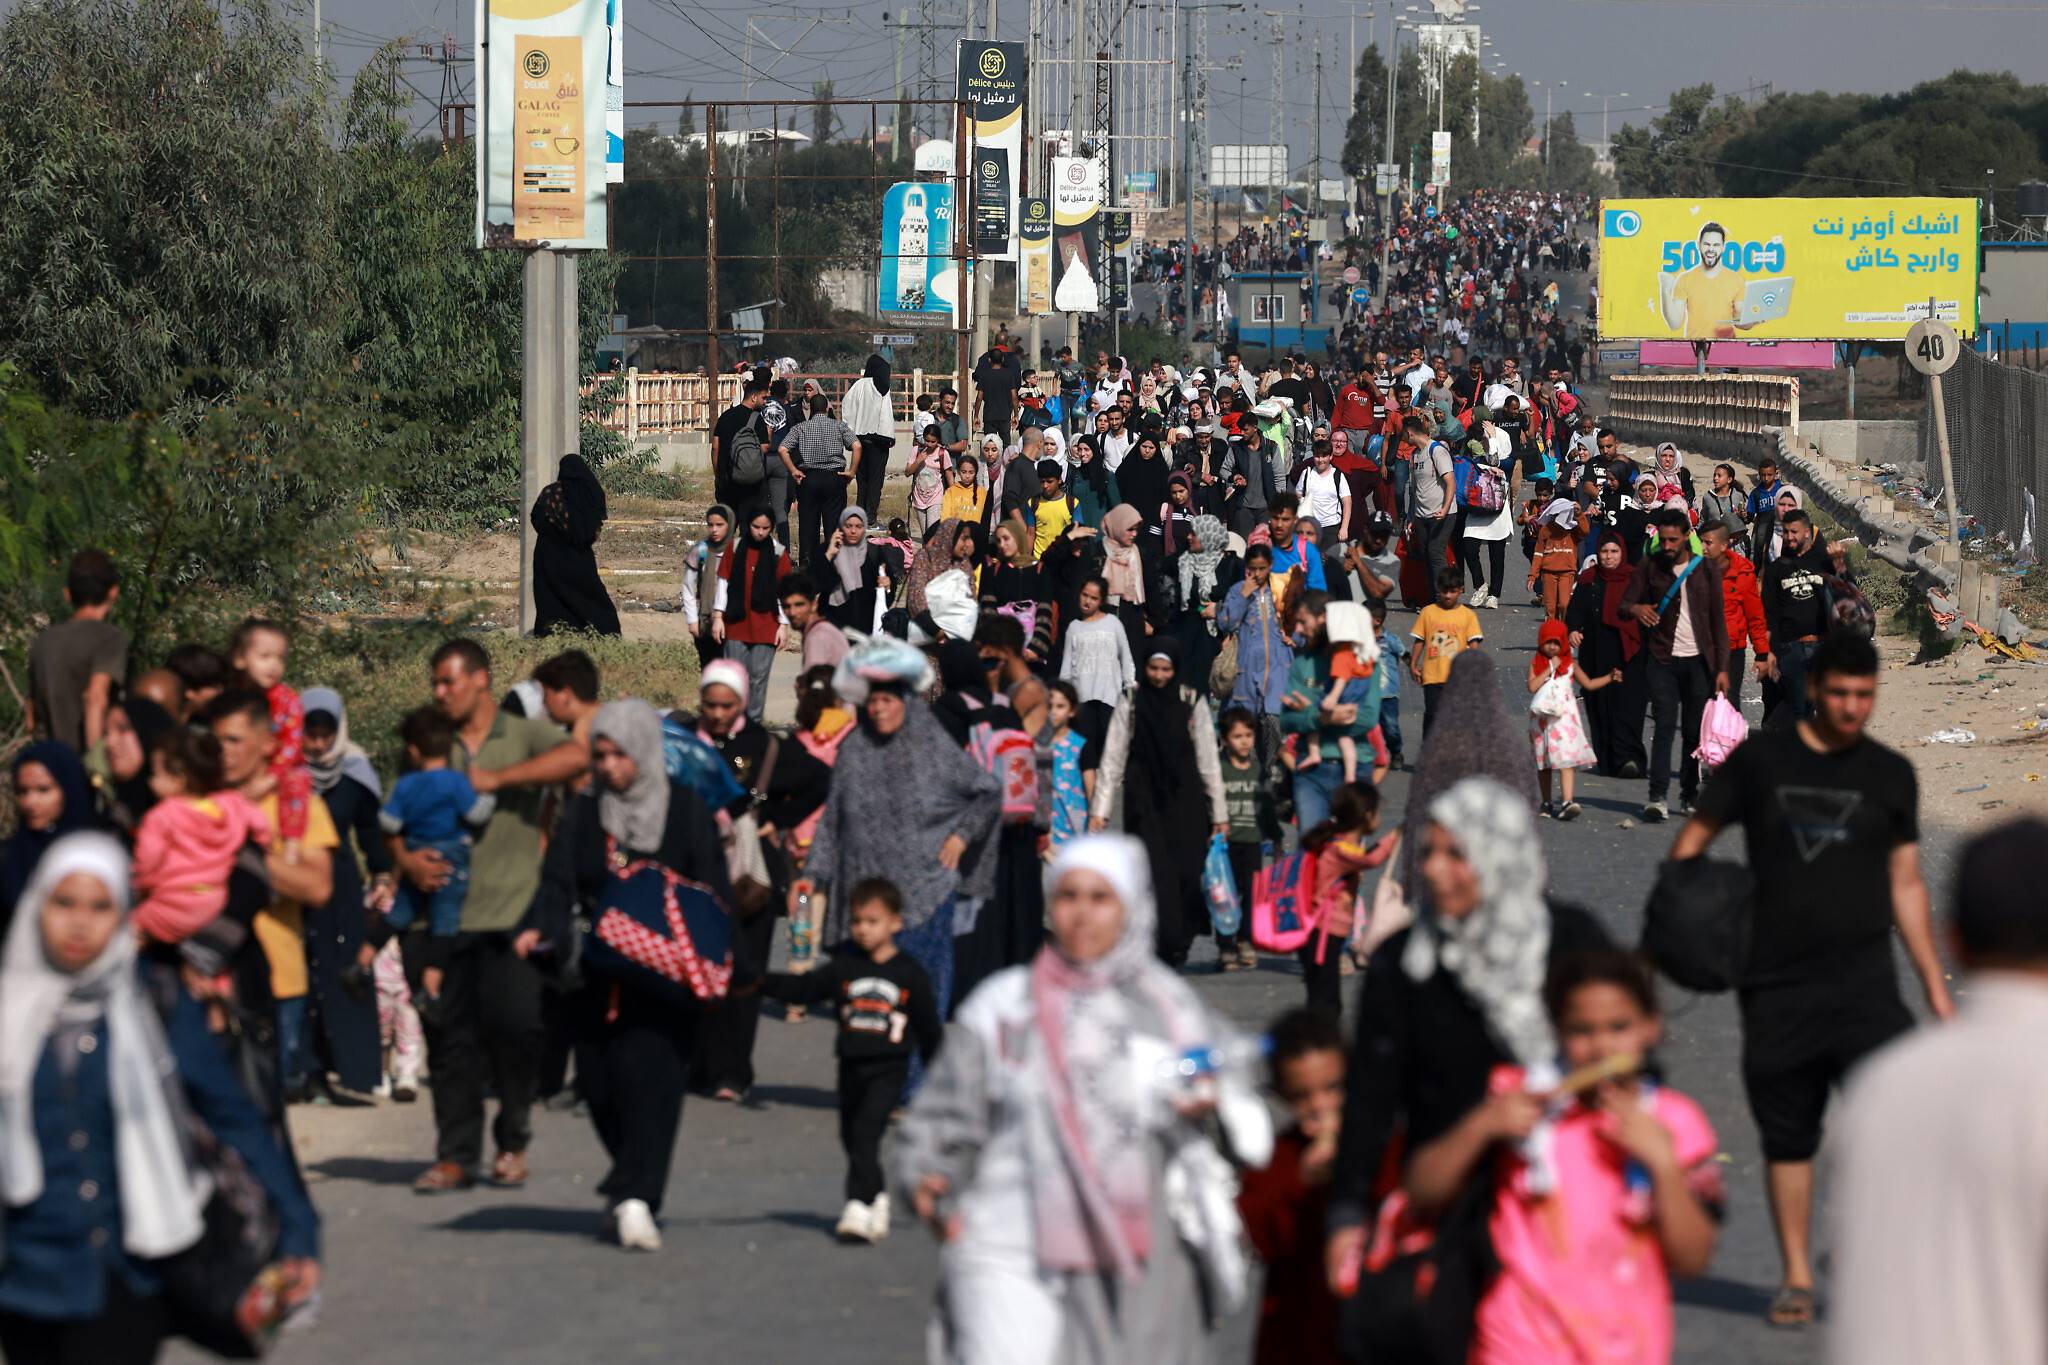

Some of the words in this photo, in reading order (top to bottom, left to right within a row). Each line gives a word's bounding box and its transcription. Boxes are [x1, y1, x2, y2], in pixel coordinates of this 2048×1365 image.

[968, 78, 992, 88] Délice
[983, 91, 1005, 105] مثيل
[1006, 92, 1015, 103] لا
[518, 99, 560, 111] GALAG
[1059, 194, 1070, 203] لها
[1070, 193, 1087, 203] مثيل
[1088, 194, 1094, 202] لا
[1812, 216, 1844, 236] نت
[1849, 210, 1895, 241] أوفر
[1901, 212, 1959, 240] اشبك
[1846, 245, 1900, 272] كاش
[1907, 247, 1960, 273] واربح
[1917, 334, 1945, 362] 40
